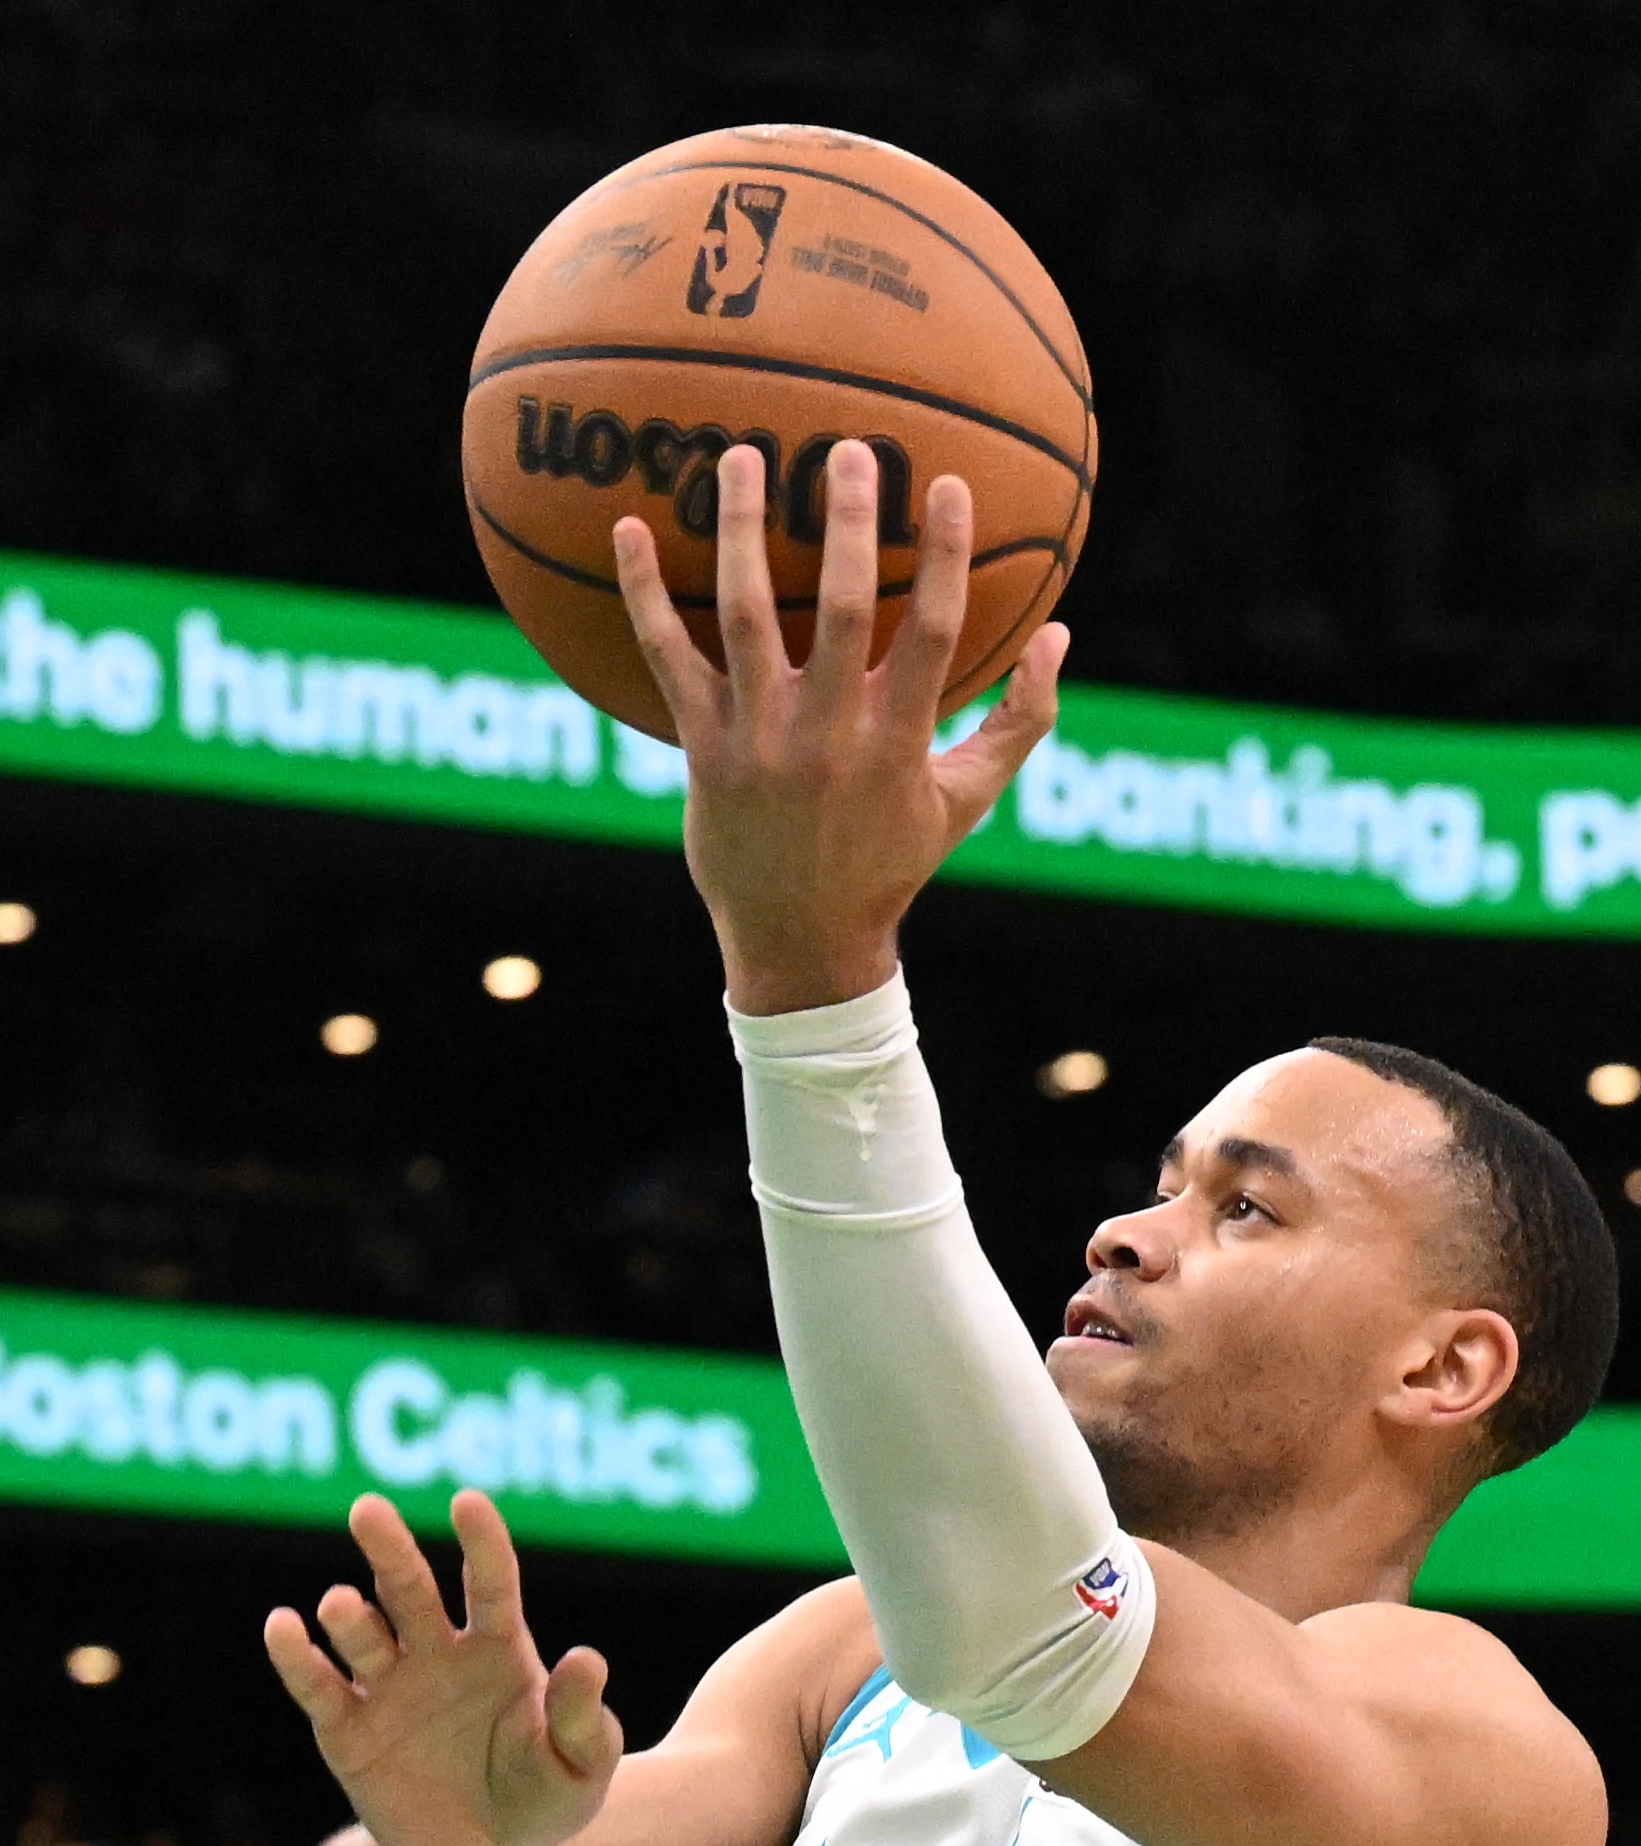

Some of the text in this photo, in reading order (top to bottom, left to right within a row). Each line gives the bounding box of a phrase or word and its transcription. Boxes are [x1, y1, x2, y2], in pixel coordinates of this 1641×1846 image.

[176, 609, 597, 786] human
[1017, 728, 1521, 906] banking,
[349, 1356, 754, 1514] Celtics
